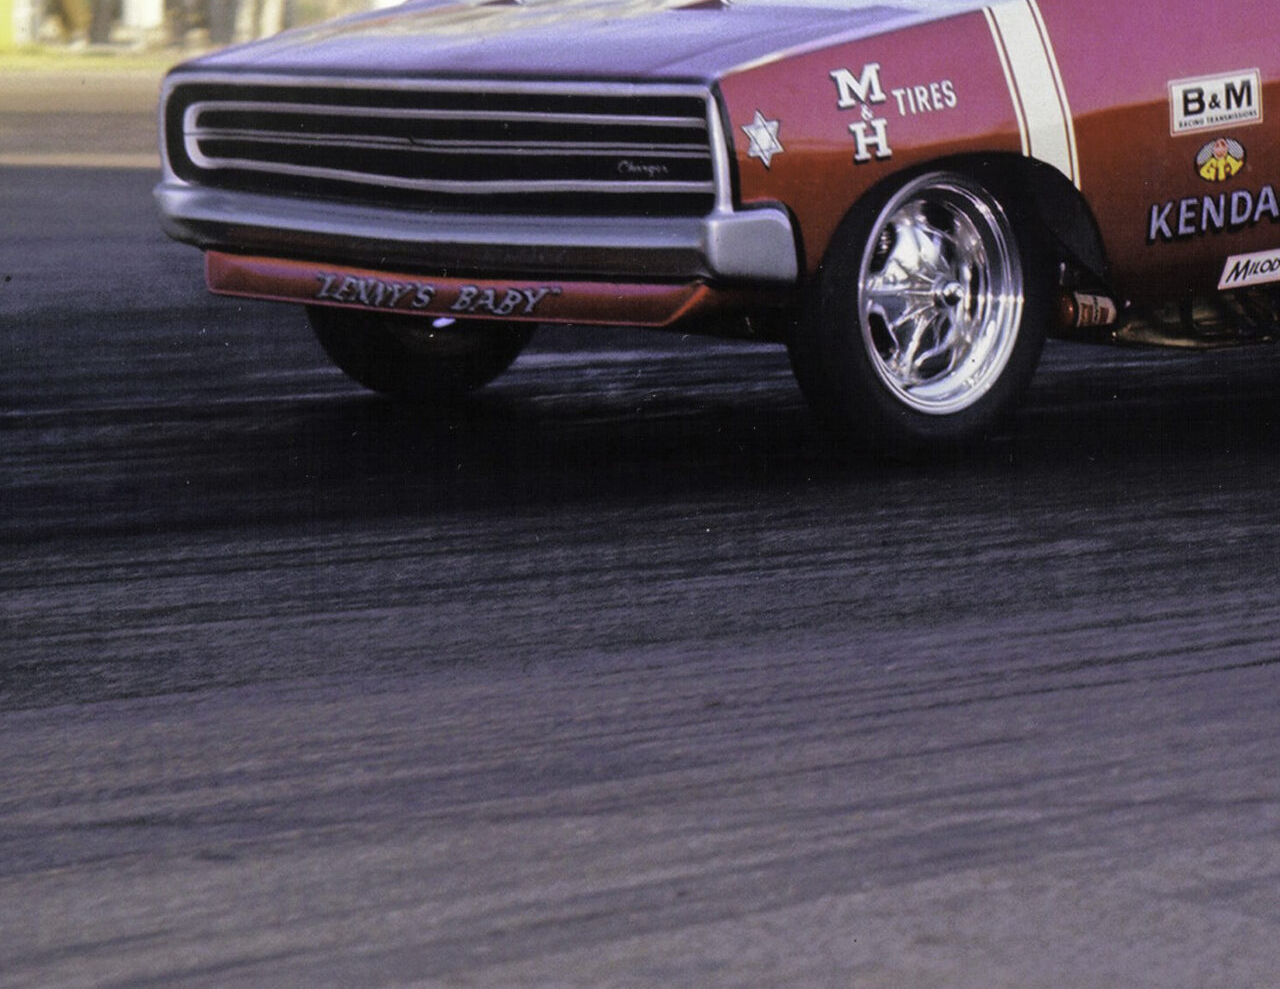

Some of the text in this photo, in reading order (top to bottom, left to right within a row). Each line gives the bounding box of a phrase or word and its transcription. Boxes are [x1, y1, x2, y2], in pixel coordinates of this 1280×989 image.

[828, 62, 888, 110] M
[890, 79, 958, 117] TIRES
[848, 117, 894, 163] H
[1178, 110, 1258, 129] RACING TRANSMISSIONS
